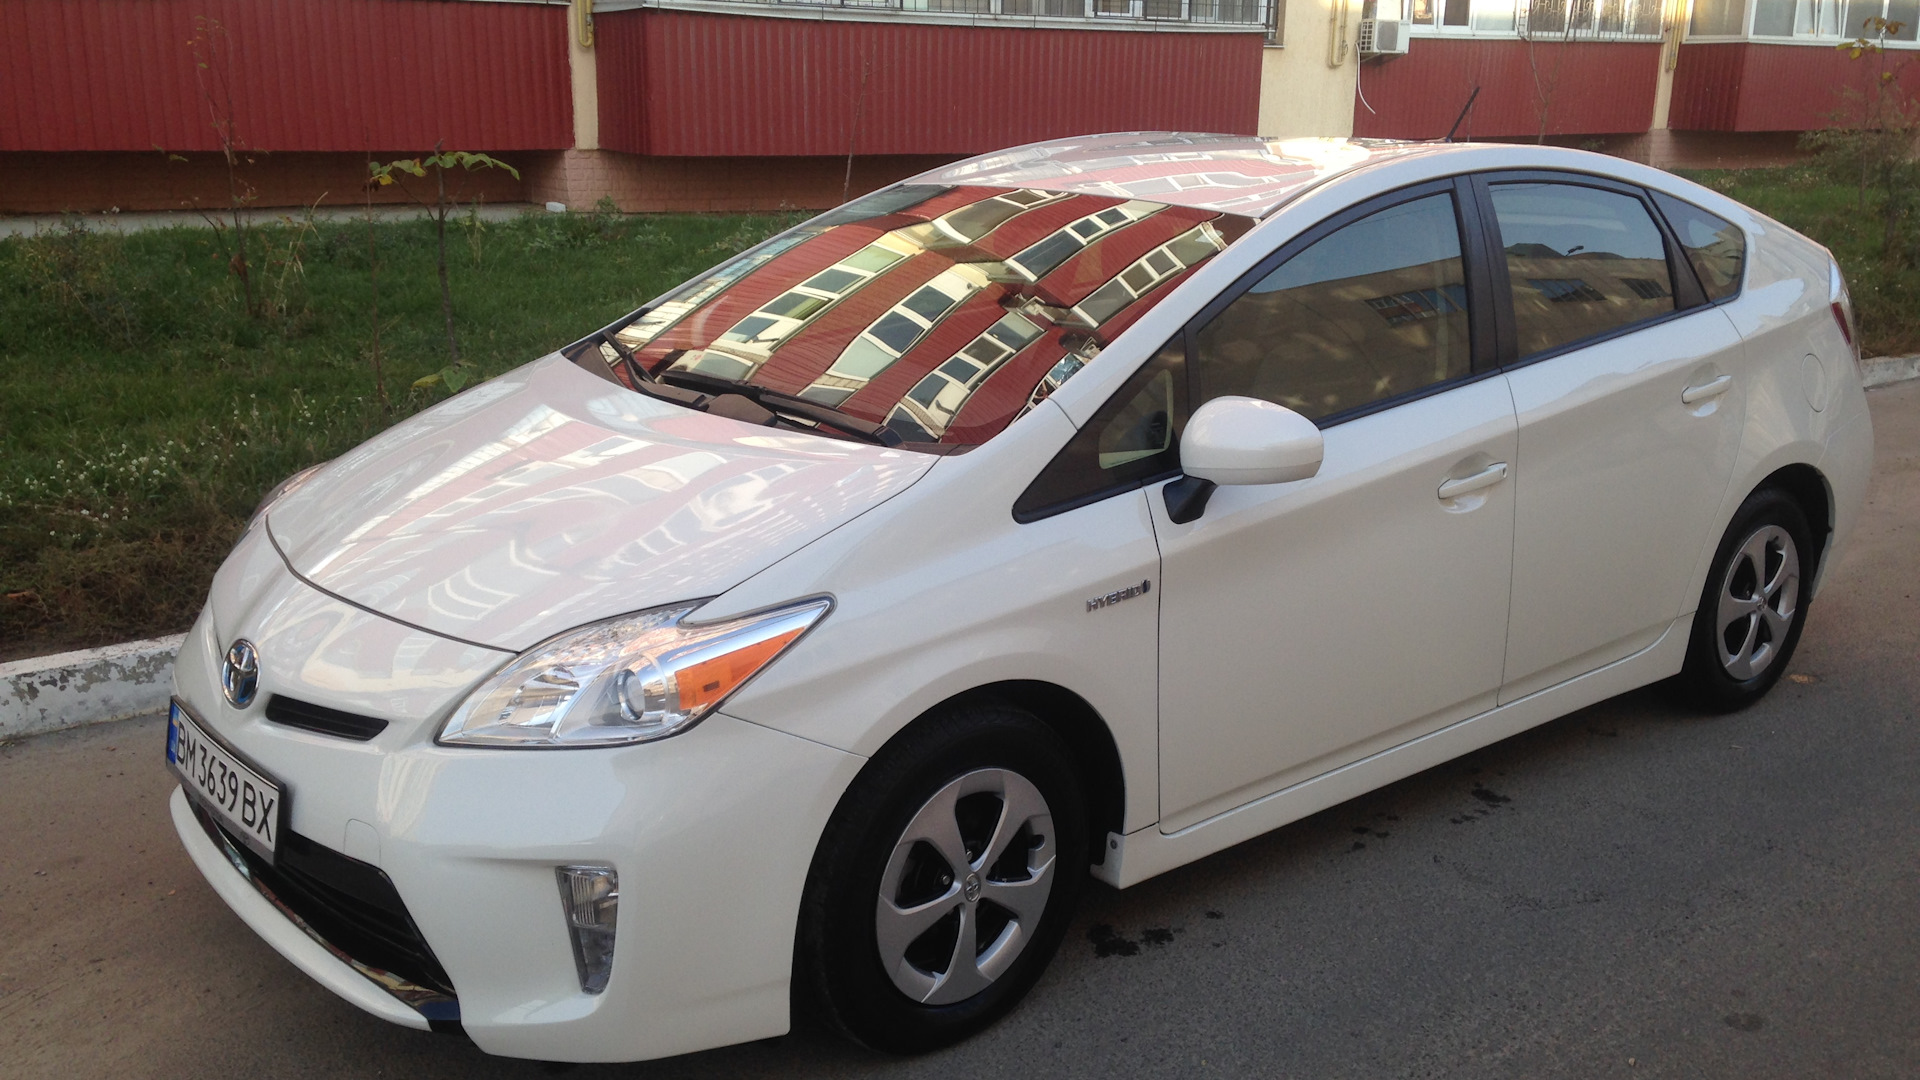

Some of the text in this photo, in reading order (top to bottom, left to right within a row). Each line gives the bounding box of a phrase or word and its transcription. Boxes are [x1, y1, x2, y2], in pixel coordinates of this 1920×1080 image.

[1086, 585, 1142, 612] HYBRID
[177, 721, 275, 842] BM 3639 BX
